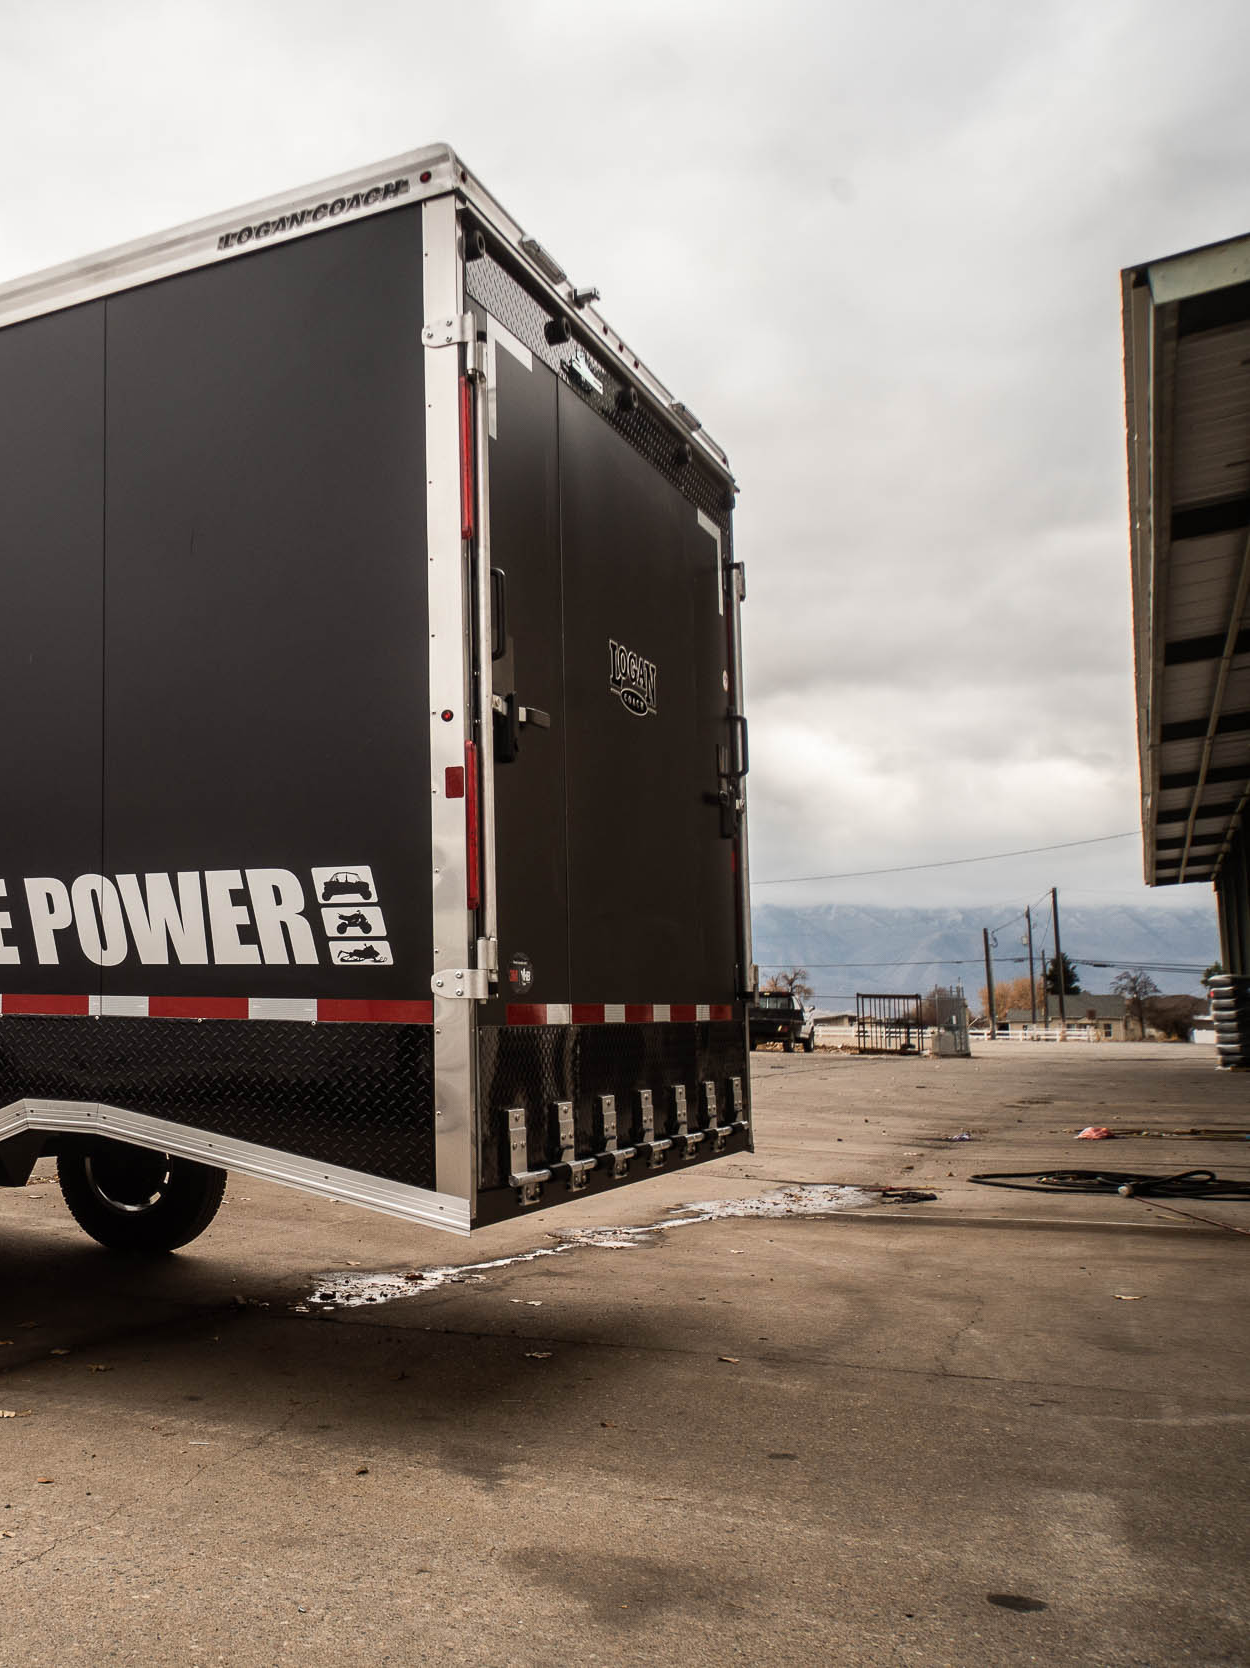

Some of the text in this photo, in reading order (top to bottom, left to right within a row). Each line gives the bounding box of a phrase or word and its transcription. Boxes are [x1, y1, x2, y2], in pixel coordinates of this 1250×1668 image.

[218, 181, 407, 251] LOGAN COACH
[609, 639, 657, 708] LOGAN
[24, 868, 320, 966] POWER
